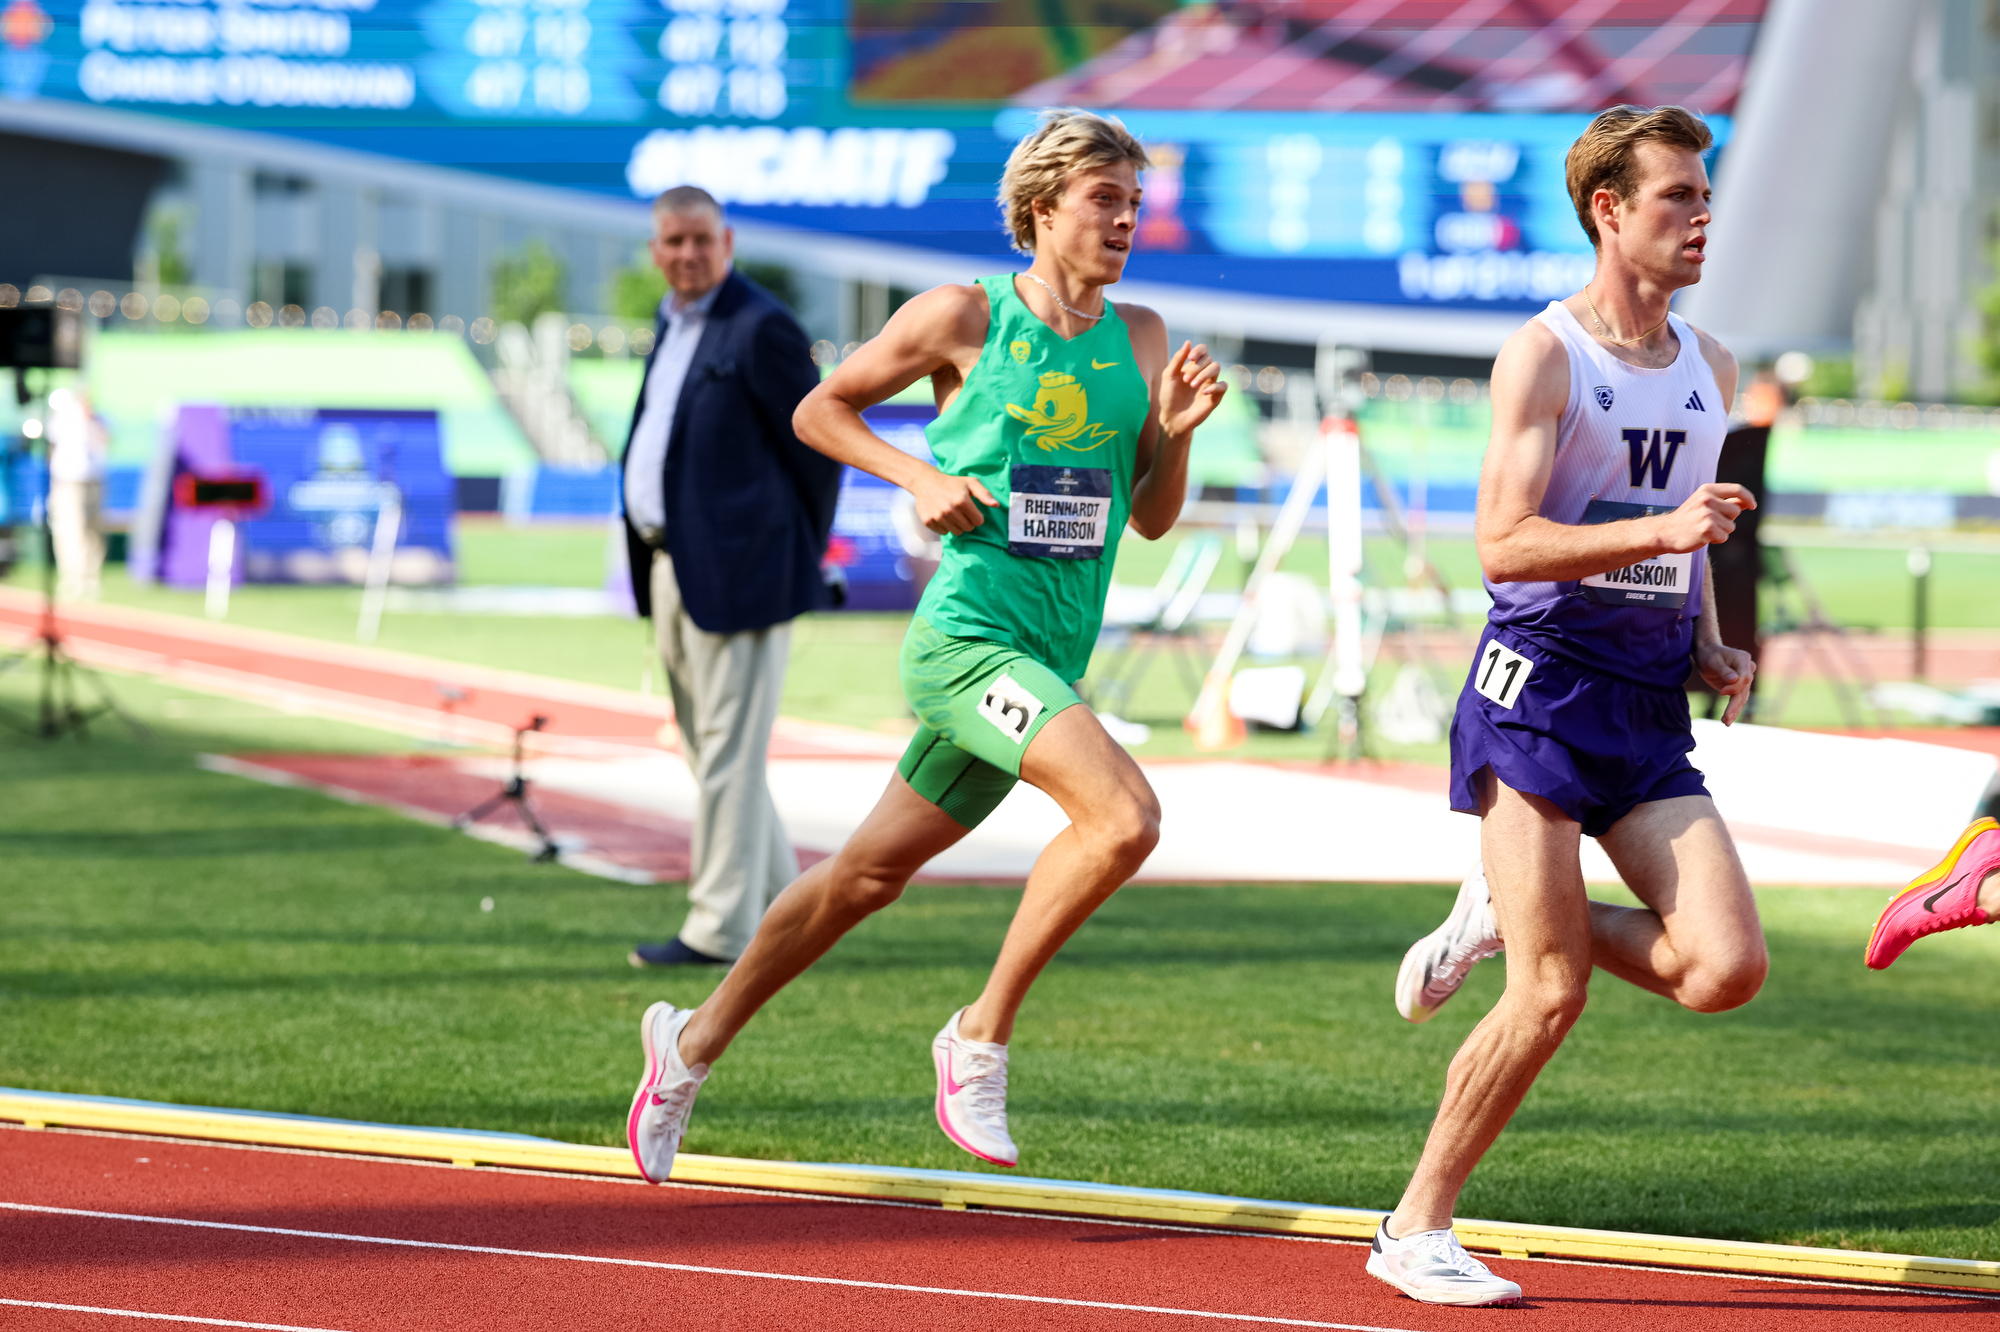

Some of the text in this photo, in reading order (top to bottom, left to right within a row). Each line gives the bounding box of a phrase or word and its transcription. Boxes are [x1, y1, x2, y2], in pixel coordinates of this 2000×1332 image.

[1621, 427, 1687, 491] W
[1024, 499, 1100, 518] RHEINHARDT
[1023, 519, 1096, 540] HARRISON
[1605, 564, 1677, 587] WASKOM
[1480, 648, 1522, 702] 11
[985, 690, 1029, 734] 3
